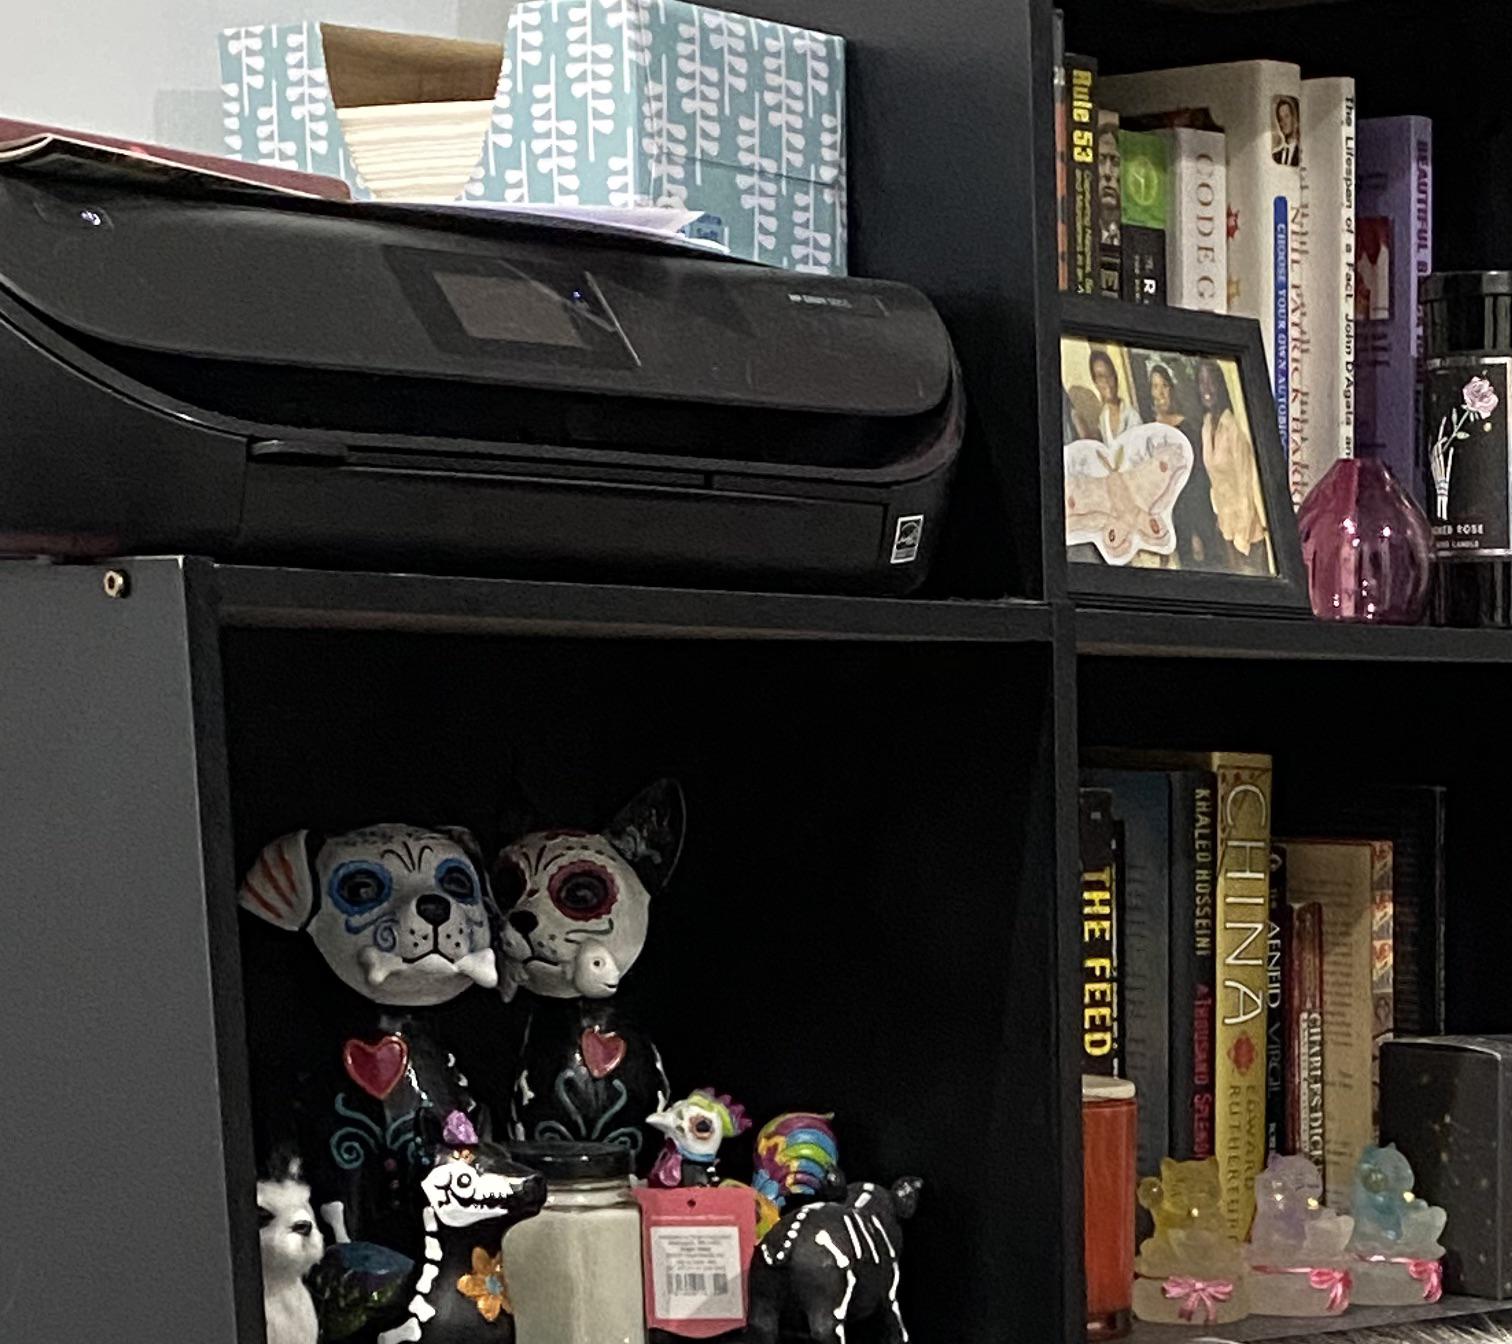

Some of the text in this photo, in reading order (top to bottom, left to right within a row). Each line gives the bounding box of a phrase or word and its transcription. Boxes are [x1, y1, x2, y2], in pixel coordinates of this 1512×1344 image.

[1072, 129, 1094, 163] 53
[1343, 97, 1355, 126] The
[1195, 153, 1215, 263] CODE
[1343, 136, 1355, 208] Lifespan
[1276, 223, 1287, 282] CHOOSE
[1342, 217, 1354, 235] of
[1343, 241, 1353, 253] a
[1276, 288, 1288, 329] YOUR
[1342, 261, 1354, 302] Fact
[1341, 313, 1354, 353] John
[1289, 417, 1304, 497] HARR
[1194, 788, 1211, 863] KHALED
[1194, 868, 1211, 957] HOSSEINI
[1224, 783, 1267, 1026] CHINA
[1083, 865, 1113, 1058] THE FEED
[1308, 1012, 1323, 1108] CHARLES
[1243, 1084, 1259, 1191] EDWARD
